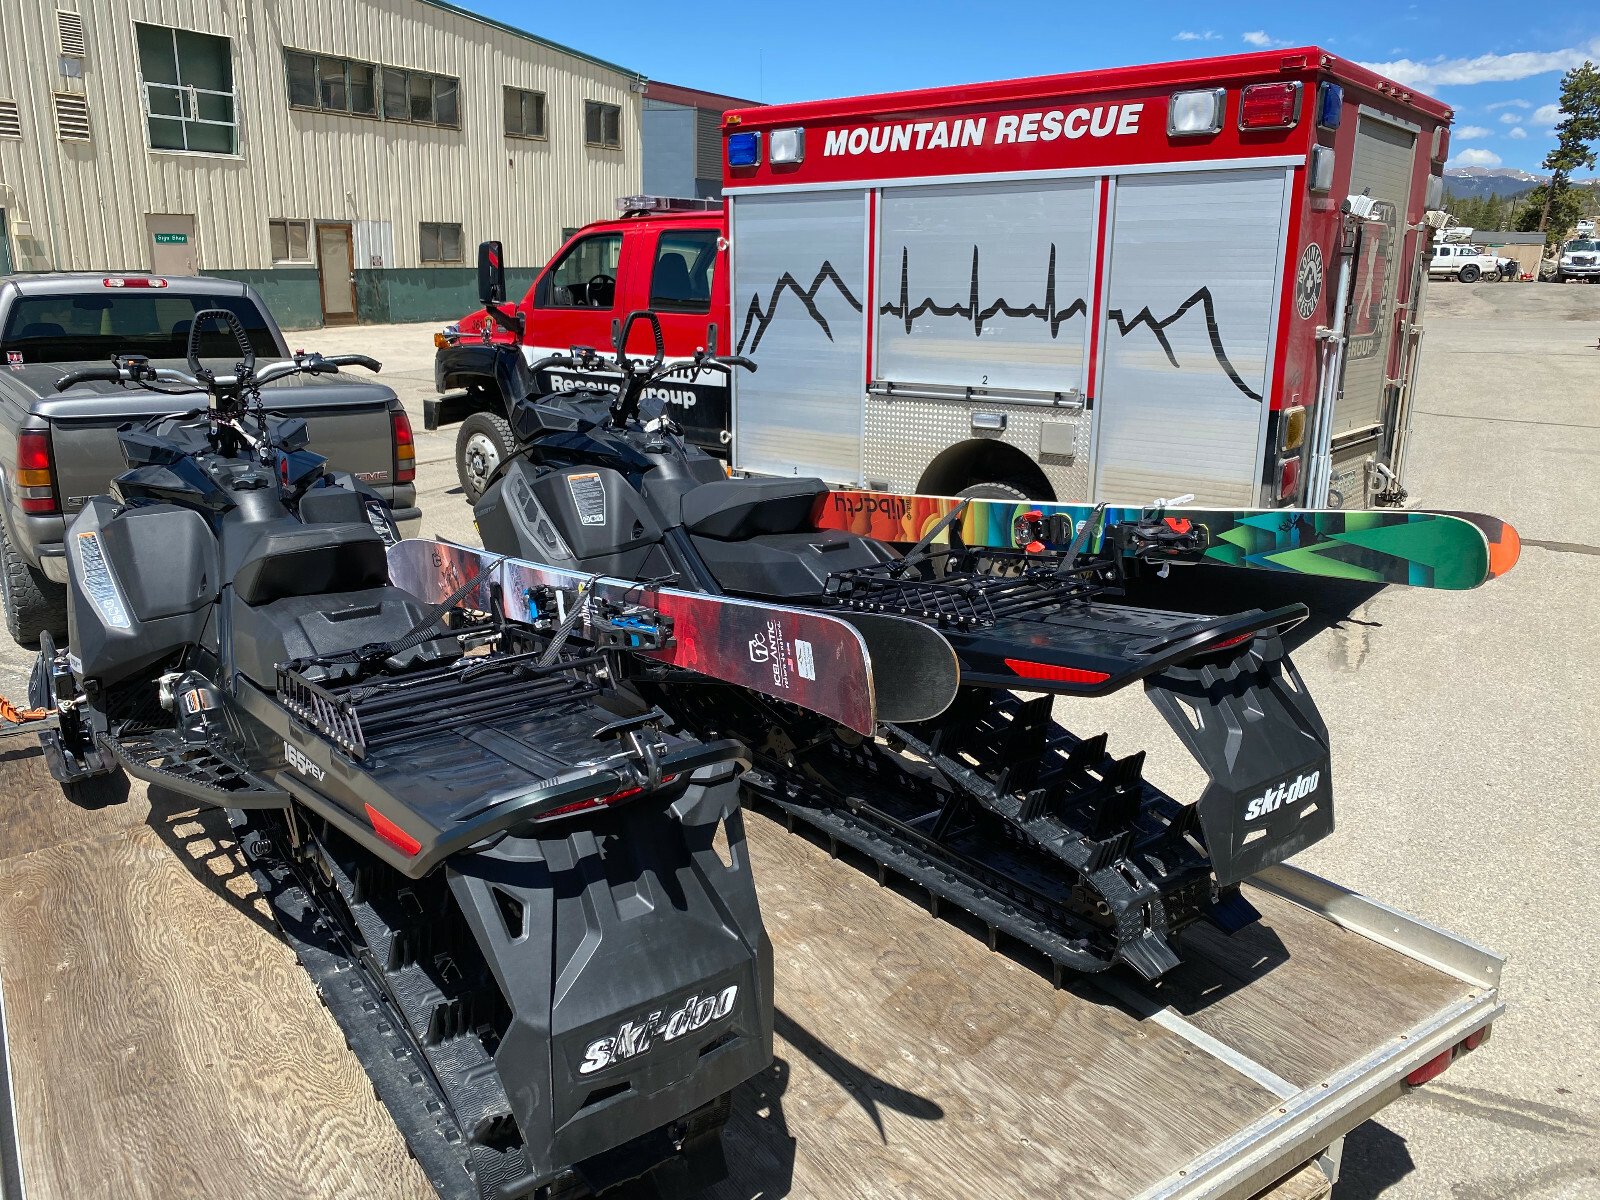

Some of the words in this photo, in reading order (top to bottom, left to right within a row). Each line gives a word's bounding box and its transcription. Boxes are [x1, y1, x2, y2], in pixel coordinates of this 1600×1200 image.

[823, 117, 987, 157] MOUNTAIN
[994, 103, 1144, 145] RESCUE
[157, 234, 170, 242] Sign
[171, 234, 185, 242] Shop
[1298, 245, 1322, 284] MOUNTAIN
[471, 319, 483, 330] 361
[981, 374, 989, 385] 2
[793, 466, 798, 475] 1
[767, 620, 782, 687] ICELANTIC
[1244, 770, 1320, 821] ski-doo
[579, 984, 739, 1075] ski-doo
